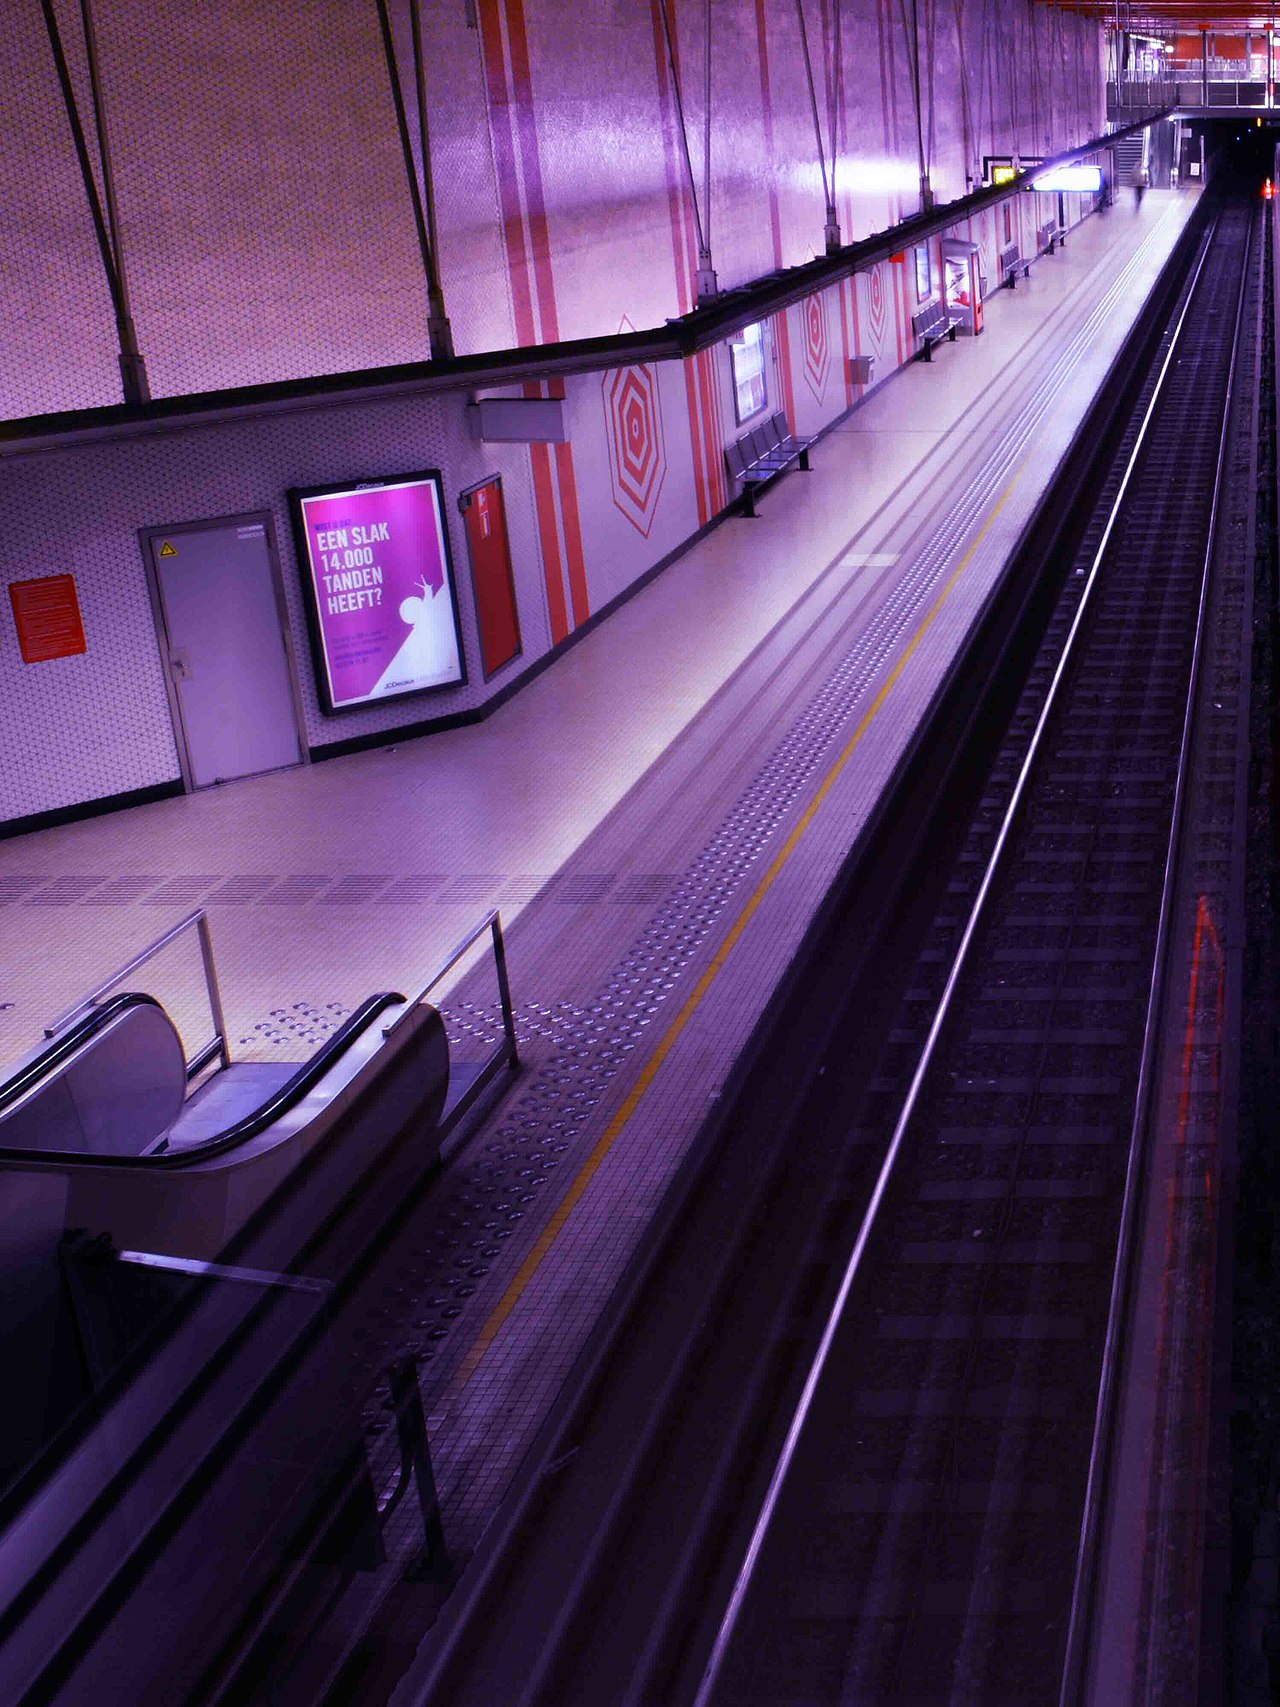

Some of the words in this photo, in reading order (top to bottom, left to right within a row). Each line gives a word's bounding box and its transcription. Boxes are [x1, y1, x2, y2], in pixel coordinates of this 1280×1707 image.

[317, 529, 348, 551] EEN
[351, 522, 390, 545] SLAK
[321, 547, 374, 572] 14.000
[323, 567, 383, 593] TANDEN
[328, 588, 382, 615] HEEFT?
